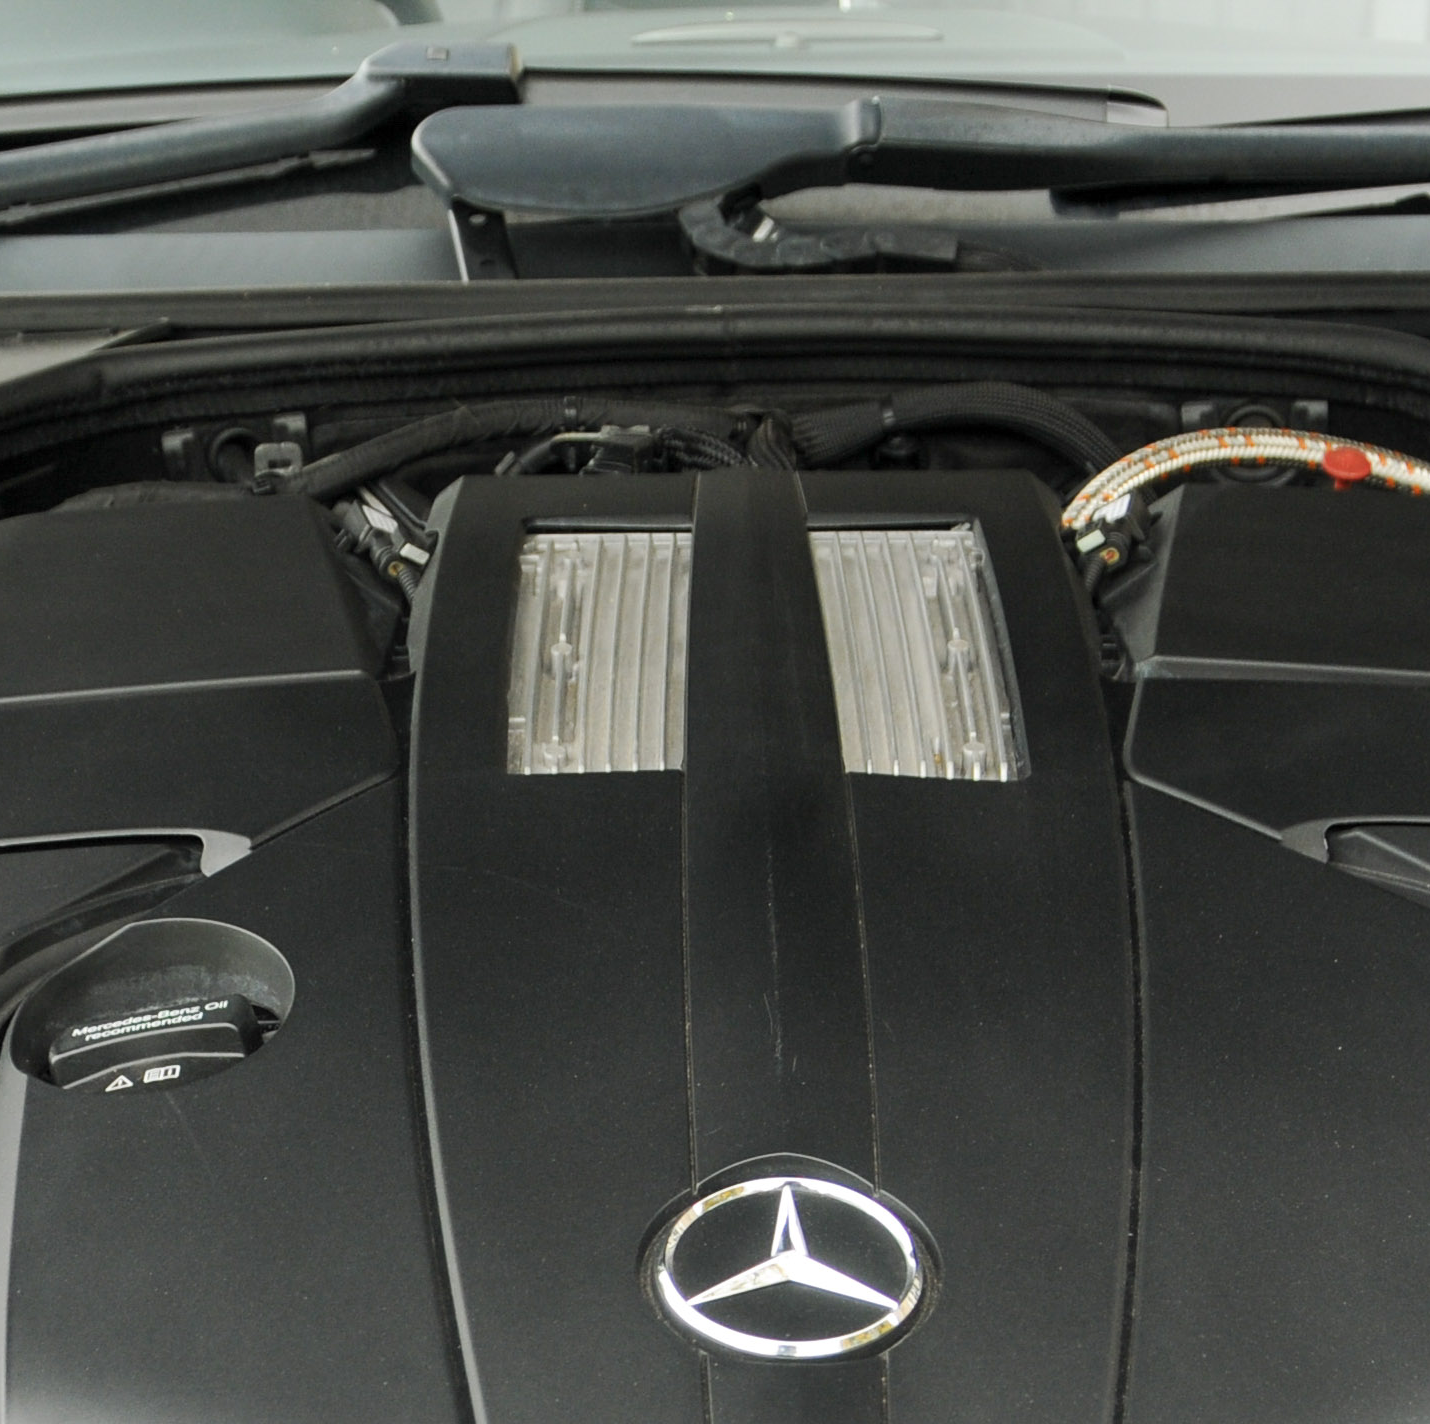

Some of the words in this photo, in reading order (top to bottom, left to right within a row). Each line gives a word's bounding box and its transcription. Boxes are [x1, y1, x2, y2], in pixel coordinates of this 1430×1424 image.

[71, 1004, 201, 1037] Mercedes-Benz
[204, 1000, 229, 1012] Oil
[84, 1011, 204, 1041] recommended
